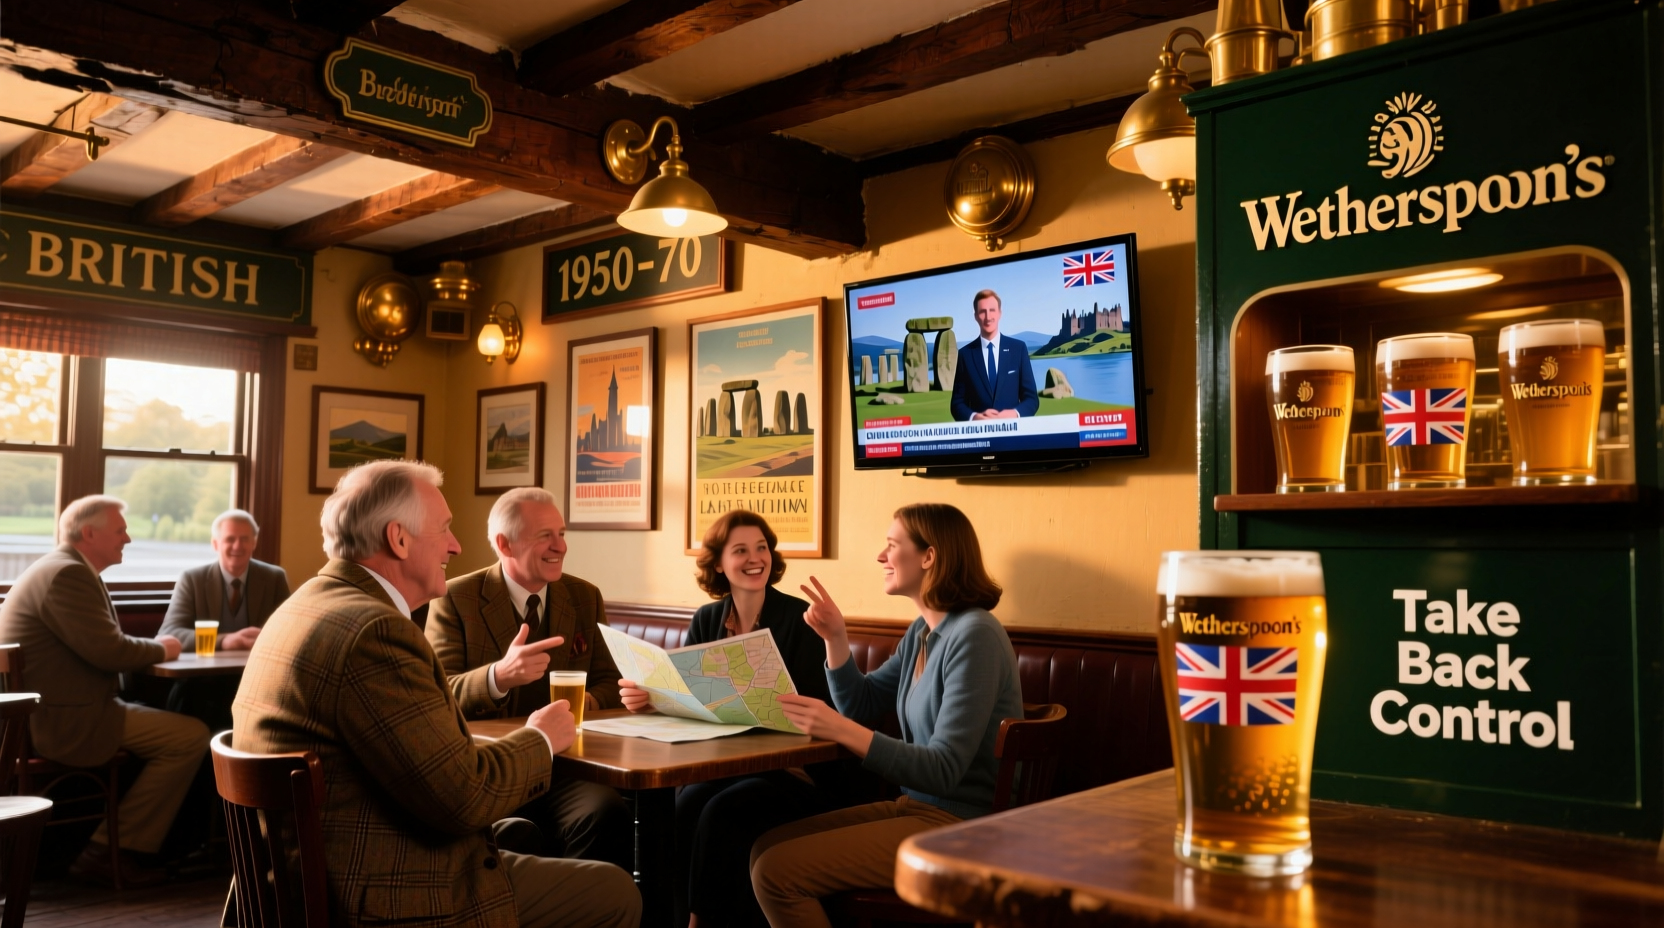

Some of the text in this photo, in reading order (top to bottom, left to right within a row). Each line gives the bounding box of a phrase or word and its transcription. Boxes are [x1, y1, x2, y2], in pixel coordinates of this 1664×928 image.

[1240, 143, 1606, 251] Wetherspoon's
[26, 230, 260, 305] BRITISH
[558, 236, 702, 302] 1950-70
[1393, 589, 1521, 637] Take
[1398, 641, 1532, 692] Back
[1370, 689, 1575, 751] Control
